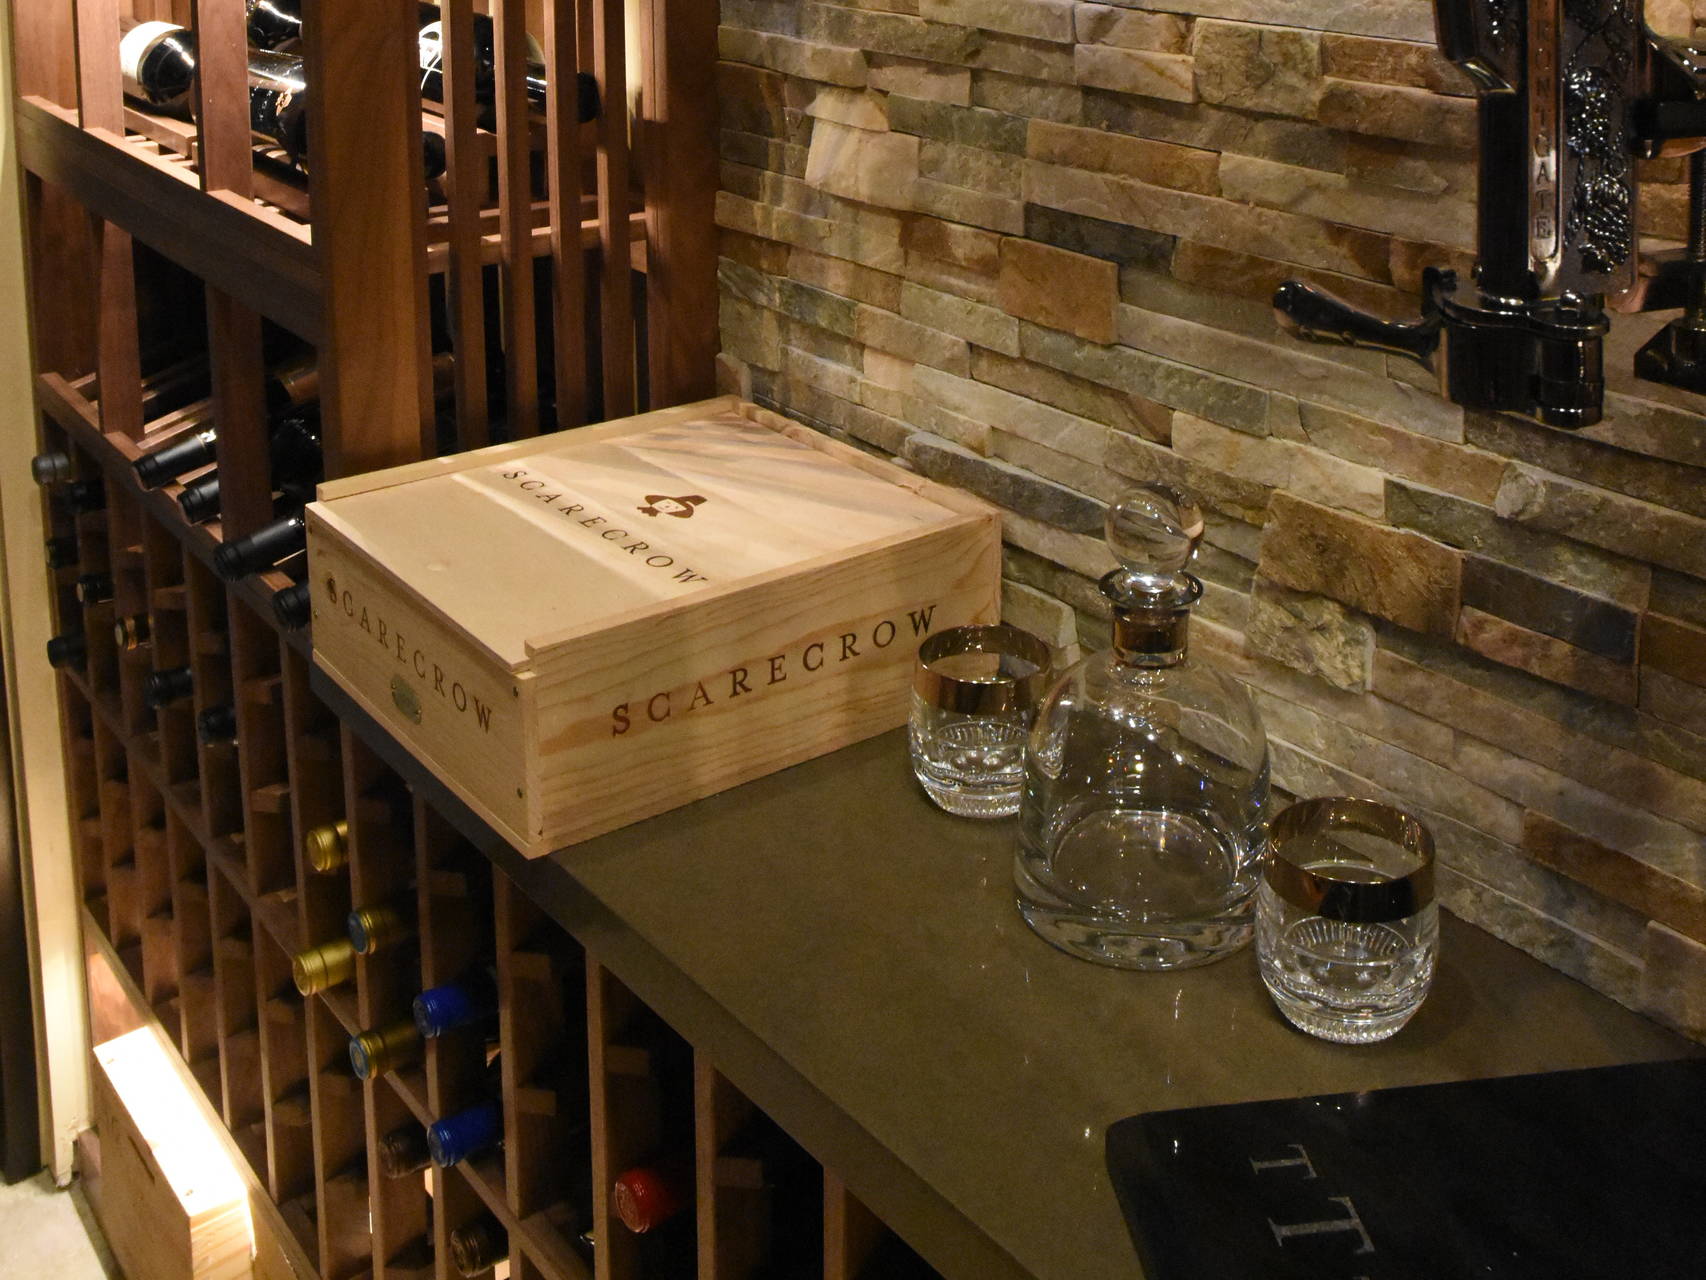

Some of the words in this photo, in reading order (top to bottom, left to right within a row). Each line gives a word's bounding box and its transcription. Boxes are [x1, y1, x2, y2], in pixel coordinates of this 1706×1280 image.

[502, 470, 708, 583] SCARECROW
[327, 578, 492, 734] SCARECROW
[612, 605, 936, 736] SCARECROW
